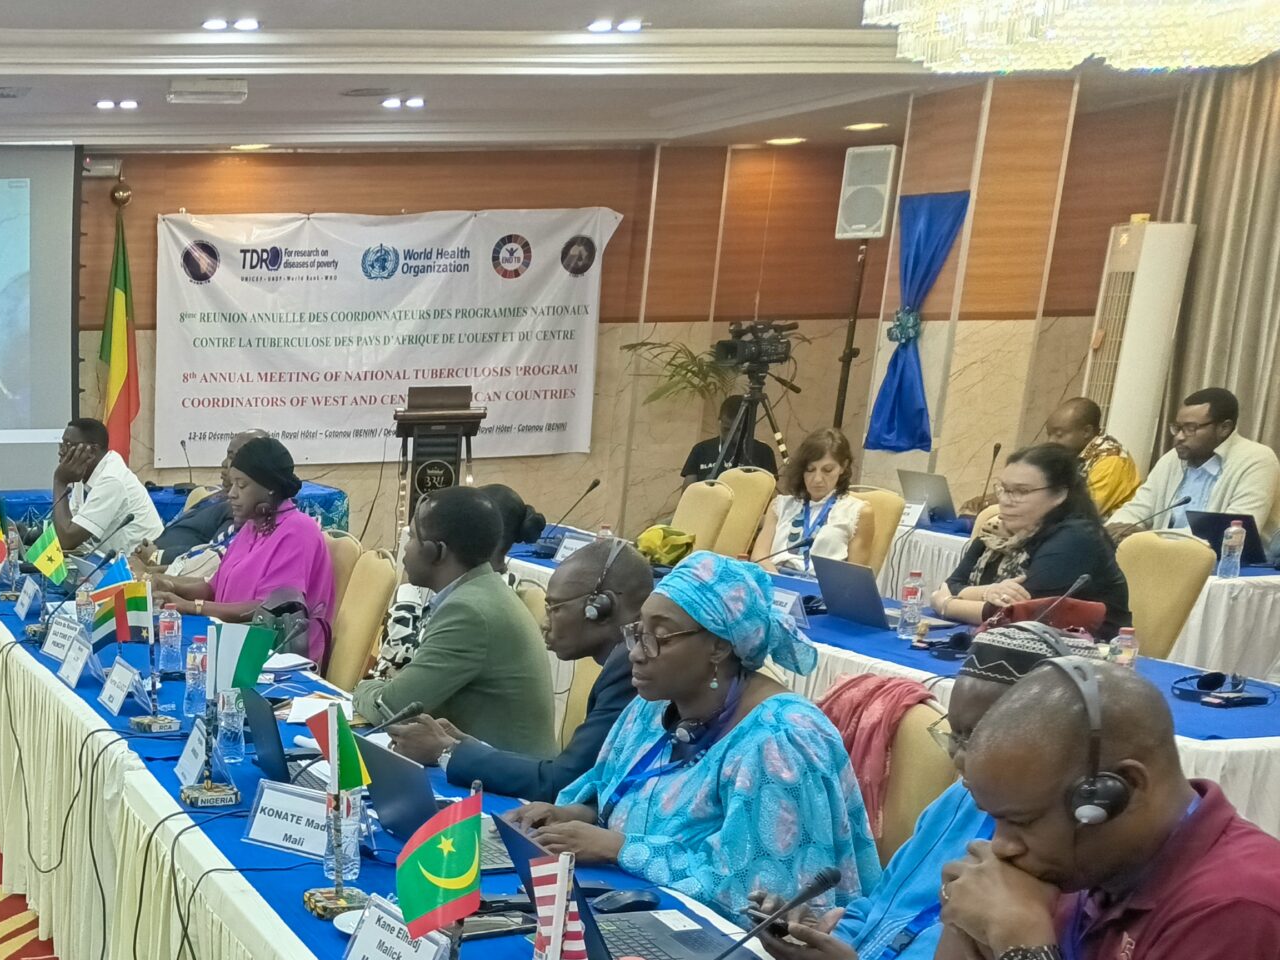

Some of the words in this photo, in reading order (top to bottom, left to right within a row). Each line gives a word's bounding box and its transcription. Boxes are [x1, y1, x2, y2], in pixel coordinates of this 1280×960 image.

[240, 249, 273, 270] TDR
[284, 248, 293, 257] For
[294, 249, 320, 257] research
[403, 248, 433, 261] World
[436, 247, 470, 260] Health
[283, 260, 308, 269] diseases
[310, 259, 316, 269] of
[317, 260, 338, 270] poverty
[401, 261, 469, 278] Organization
[199, 312, 247, 324] REUNION
[249, 312, 305, 324] ANNUELLE
[308, 311, 329, 323] DES
[330, 309, 431, 323] COORDONNATEURS
[433, 308, 453, 320] DES
[454, 306, 528, 319] PROGRAMMES
[531, 303, 590, 317] NATIONAUX
[193, 337, 236, 348] CONTRE
[238, 337, 252, 348] LA
[255, 336, 331, 348] TUBERCULOSE
[334, 336, 355, 346] DES
[357, 335, 381, 346] PAYS
[383, 333, 439, 347] D'AFRIQUE
[442, 333, 454, 345] DE
[502, 331, 514, 342] ET
[519, 330, 534, 342] DU
[536, 329, 576, 341] CENTRE
[182, 371, 197, 384] 8th
[200, 371, 254, 383] ANNUAL
[257, 370, 320, 383] MEETING
[323, 370, 341, 382] OF
[344, 369, 410, 381] NATIONAL
[412, 365, 511, 380] TUBERCULOSIS
[516, 363, 579, 376] PROGRAM
[181, 396, 286, 408] COORDINATORS
[290, 395, 310, 407] OF
[311, 395, 347, 407] WEST
[350, 394, 377, 406] AND
[380, 394, 409, 406] CEN
[471, 390, 504, 403] ICAN
[505, 388, 576, 401] COUNTRIES
[281, 430, 299, 440] Royal
[352, 428, 378, 438] (BENIN)
[200, 796, 234, 805] NIGERIA
[259, 805, 304, 826] KONATE
[282, 832, 305, 847] Mali
[374, 914, 396, 935] Kane
[395, 926, 423, 953] Elhadj
